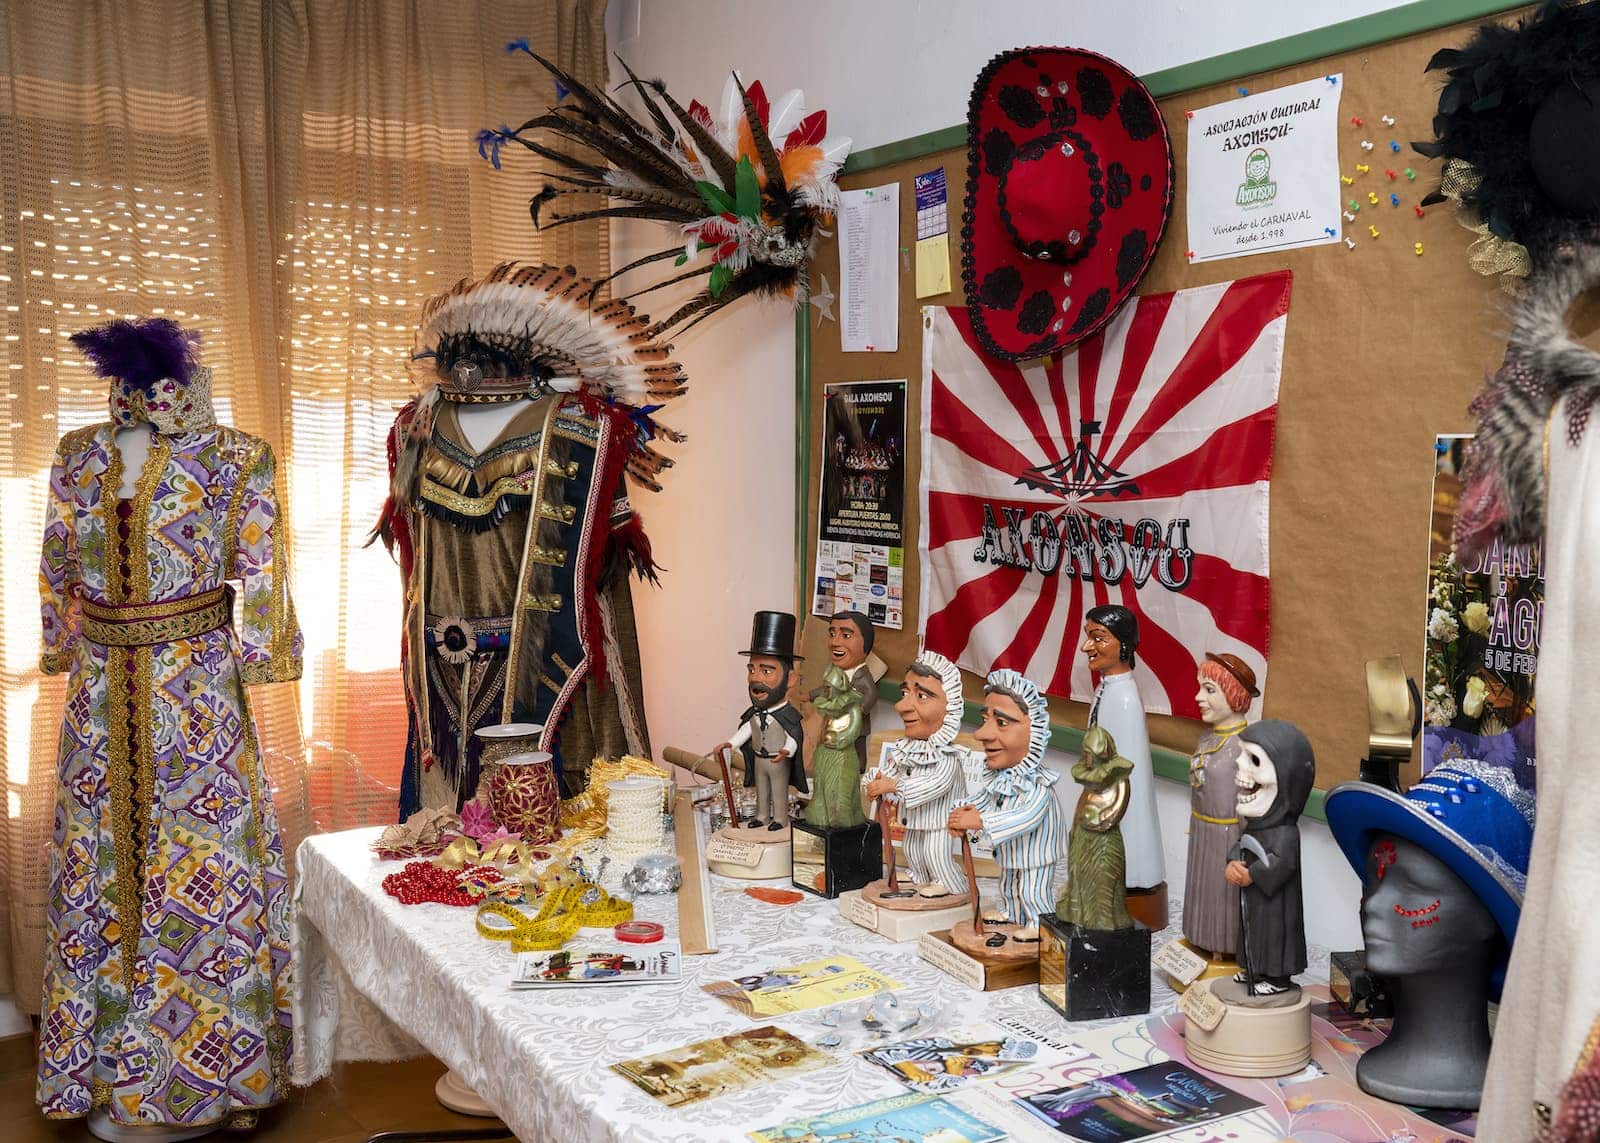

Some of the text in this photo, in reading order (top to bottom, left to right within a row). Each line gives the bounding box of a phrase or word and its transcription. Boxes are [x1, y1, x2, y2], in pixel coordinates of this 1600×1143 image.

[1270, 98, 1320, 120] CULTURAL
[1212, 209, 1312, 235] Viviendo el CARNAVAL
[1236, 232, 1258, 244] desde
[860, 392, 893, 403] AXONSOU
[973, 503, 1195, 592] AXONSOU
[1484, 649, 1494, 669] 5
[1495, 650, 1512, 672] DE
